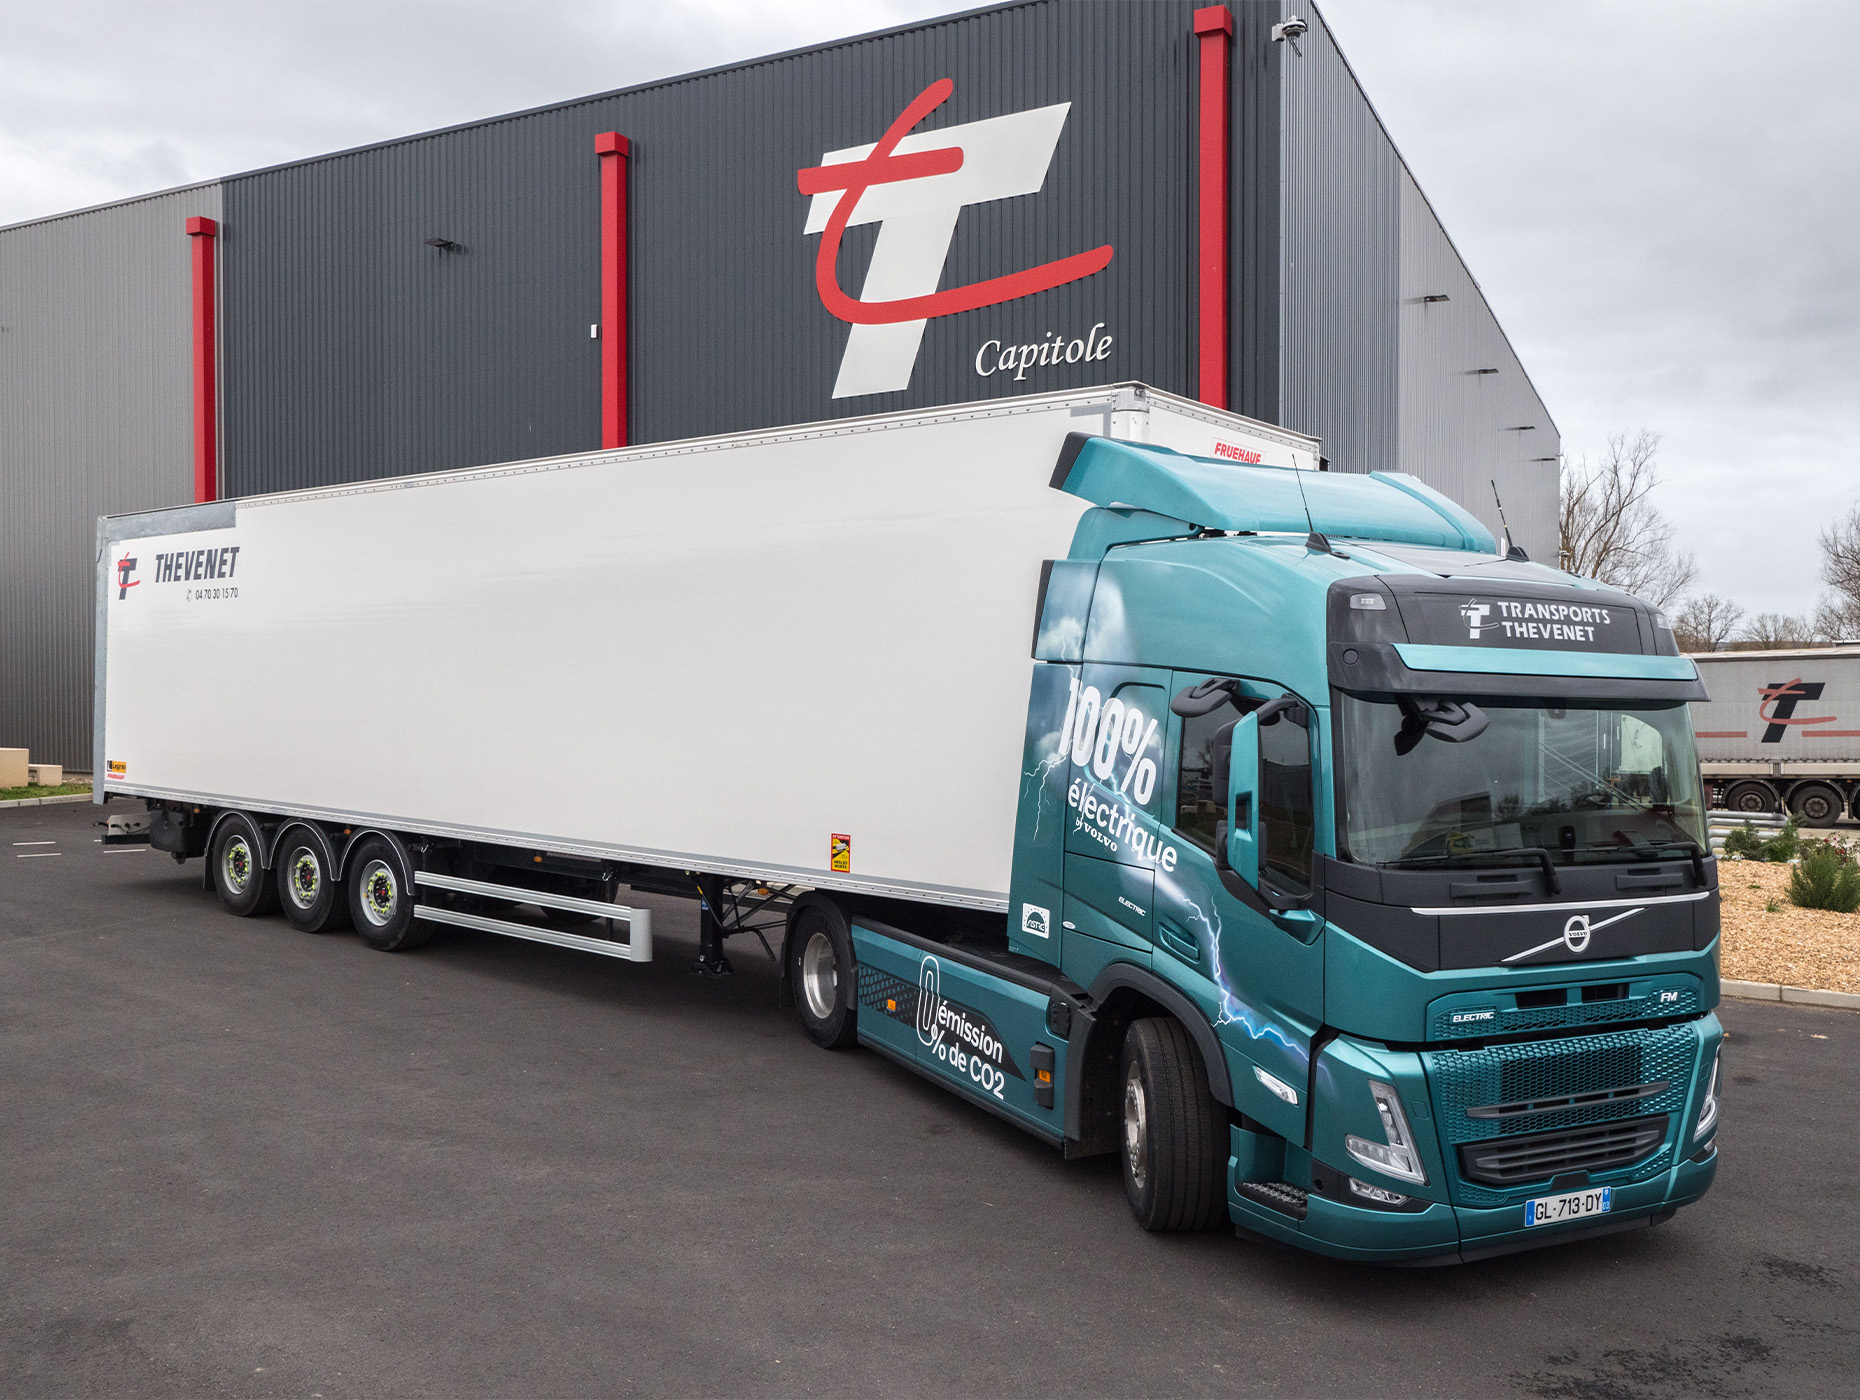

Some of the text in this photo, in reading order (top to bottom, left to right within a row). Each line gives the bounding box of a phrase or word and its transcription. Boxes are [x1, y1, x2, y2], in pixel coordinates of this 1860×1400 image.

[975, 322, 1113, 381] Capitole
[1214, 442, 1262, 465] FRUEHAUF
[155, 546, 240, 583] THEVENET
[195, 587, 239, 600] 04 70 30 15 70
[1497, 601, 1611, 625] TRANSPORTS
[1501, 621, 1595, 642] THEVENET
[1058, 677, 1158, 806] 100%
[1068, 777, 1178, 872] électrique
[1083, 822, 1118, 852] VOLVO
[1118, 896, 1147, 917] ELECTRIC
[1660, 991, 1678, 1003] FM
[1452, 1011, 1495, 1023] ELECTRIC
[938, 1000, 1003, 1064] émission
[949, 1042, 967, 1073] de
[969, 1055, 1005, 1101] CO2
